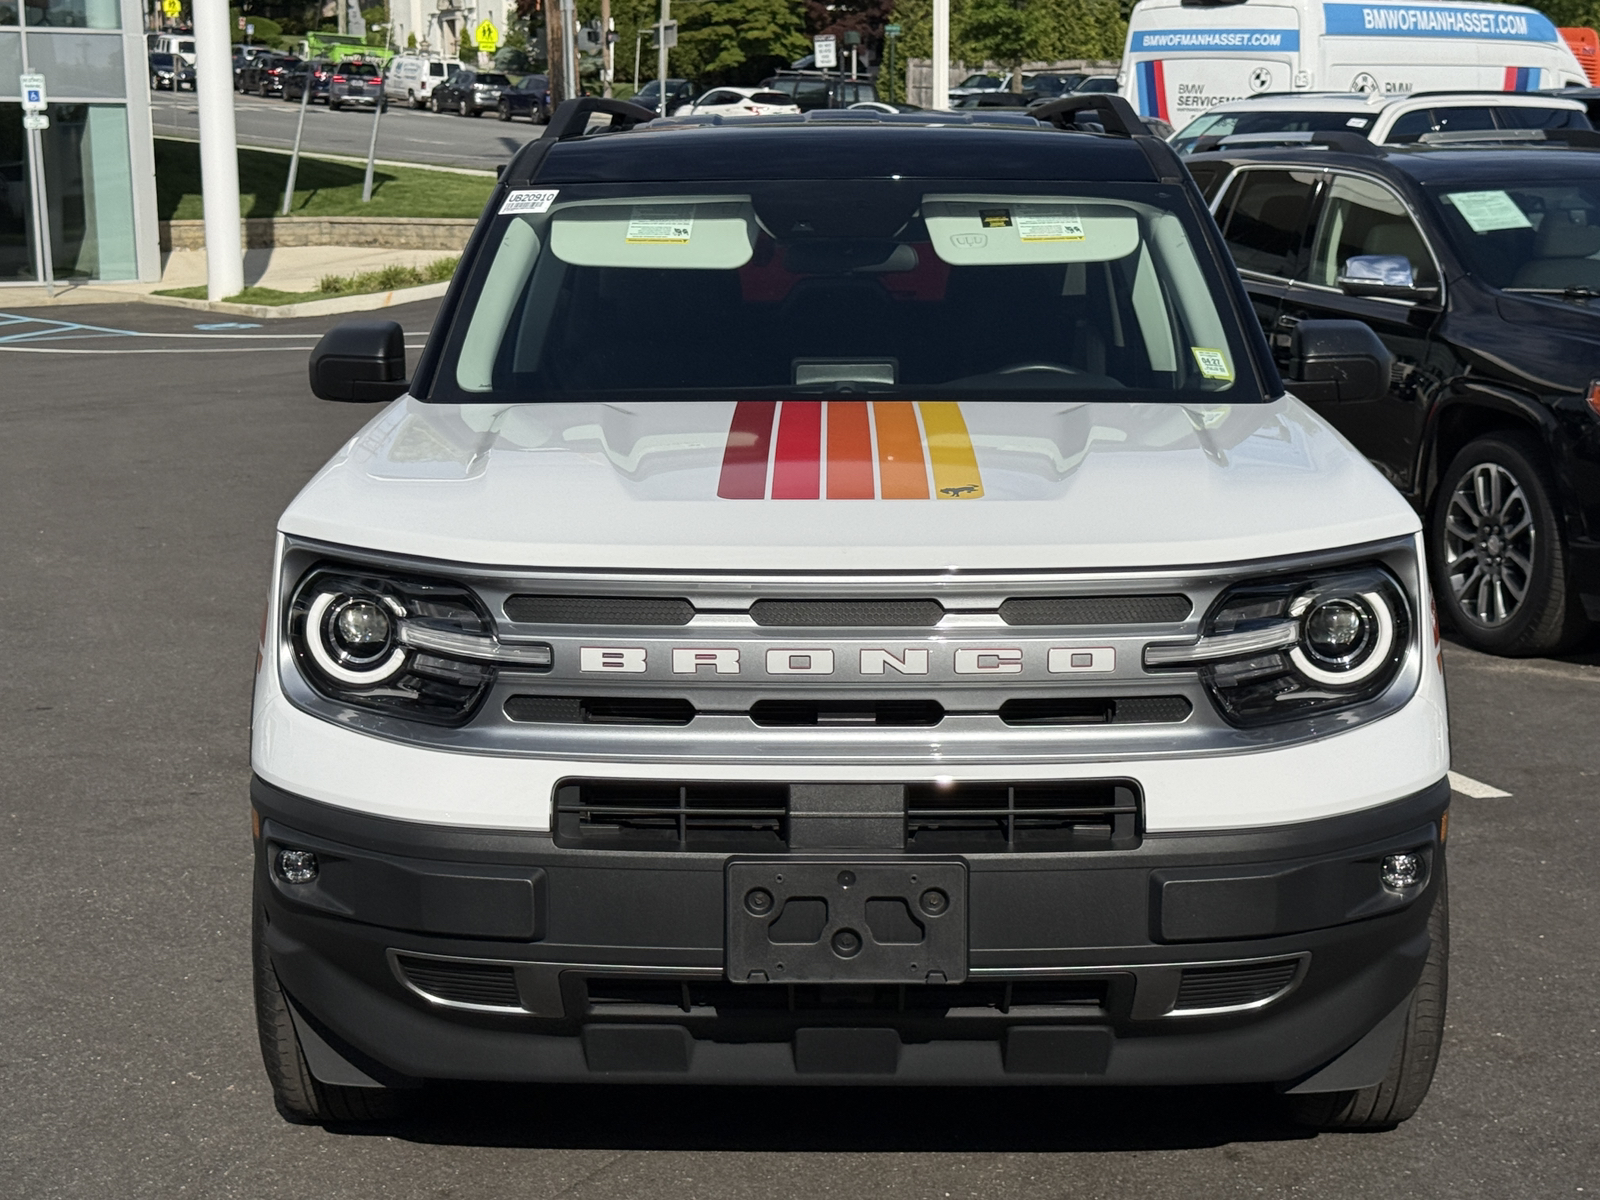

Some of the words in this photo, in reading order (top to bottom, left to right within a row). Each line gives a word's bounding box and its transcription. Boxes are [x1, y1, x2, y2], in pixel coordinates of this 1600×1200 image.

[1362, 8, 1528, 35] BMWOFMANHASSET.COM
[1142, 33, 1282, 47] BMWOFMANHASSET.COM
[1178, 84, 1205, 95] BMW
[508, 193, 555, 202] UB20910
[580, 646, 1117, 676] BRONCO
